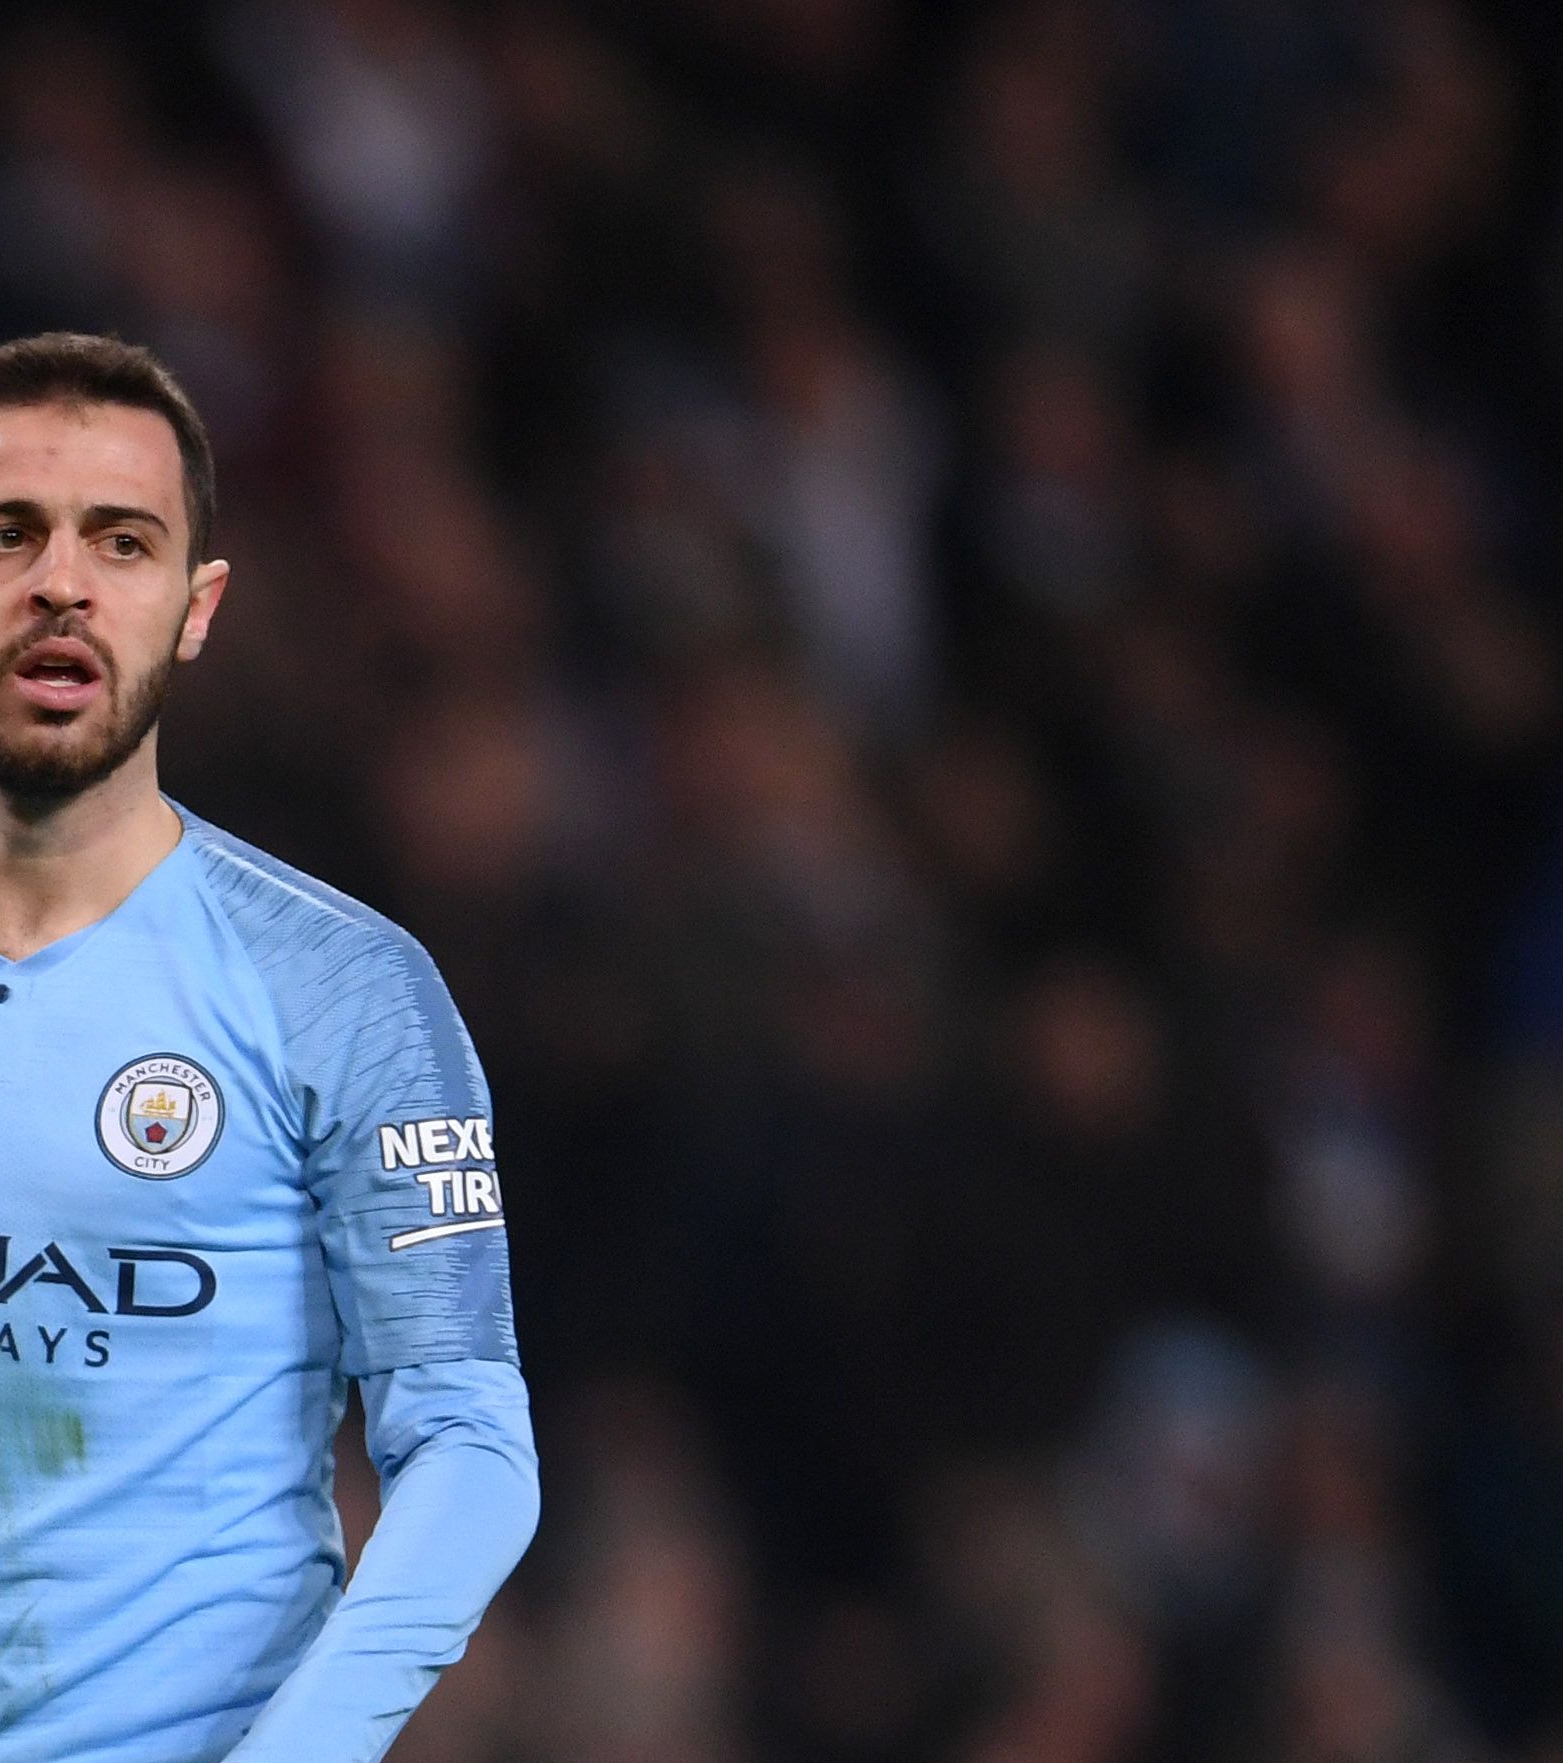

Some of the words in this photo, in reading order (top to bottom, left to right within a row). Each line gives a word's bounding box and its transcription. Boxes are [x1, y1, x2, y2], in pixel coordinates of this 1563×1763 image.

[114, 1063, 211, 1102] MANCHESTER
[134, 1156, 171, 1171] CITY
[415, 1168, 504, 1217] TIR
